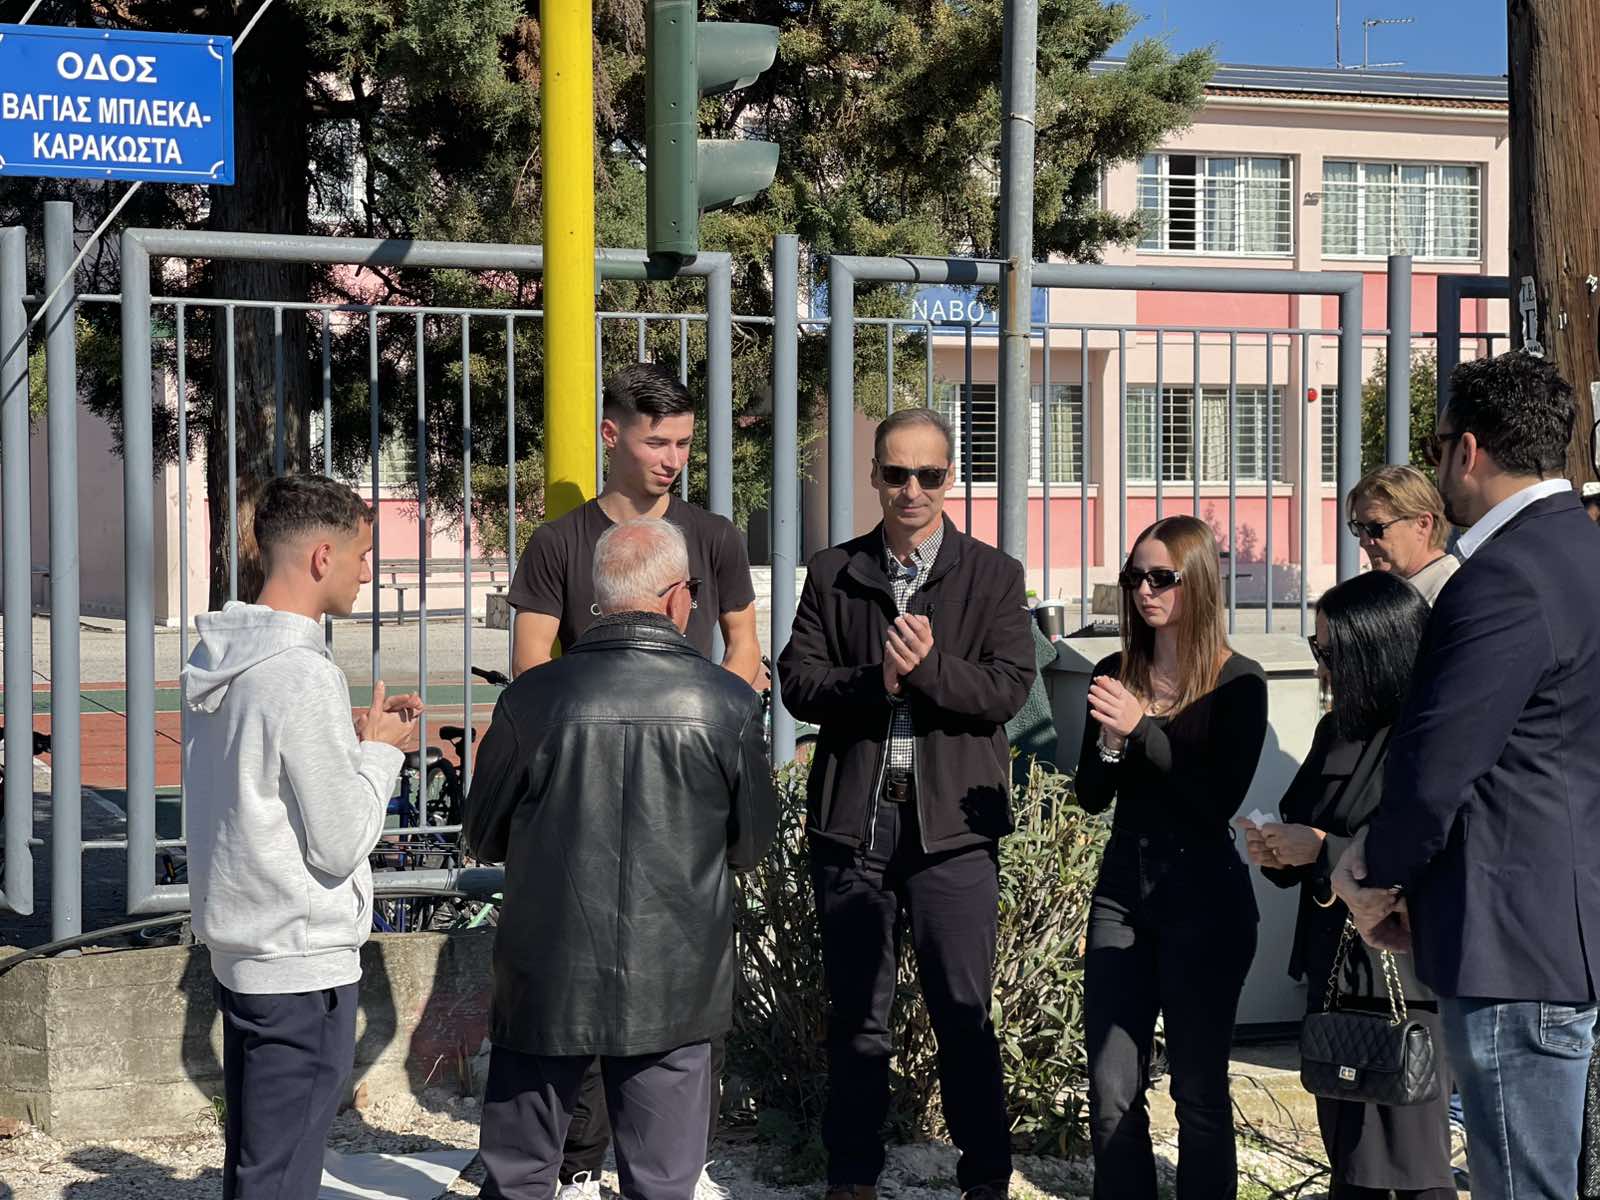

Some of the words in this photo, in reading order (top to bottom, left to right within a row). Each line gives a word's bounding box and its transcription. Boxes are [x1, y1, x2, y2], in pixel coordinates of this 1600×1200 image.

[57, 52, 157, 83] ΟΔΟΣ
[2, 93, 91, 122] ΒΑΓΙΑΣ
[99, 98, 212, 128] ΜΠΛΕΚΑ-
[33, 132, 182, 164] ΚΑΡΑΚΩΣΤΑ
